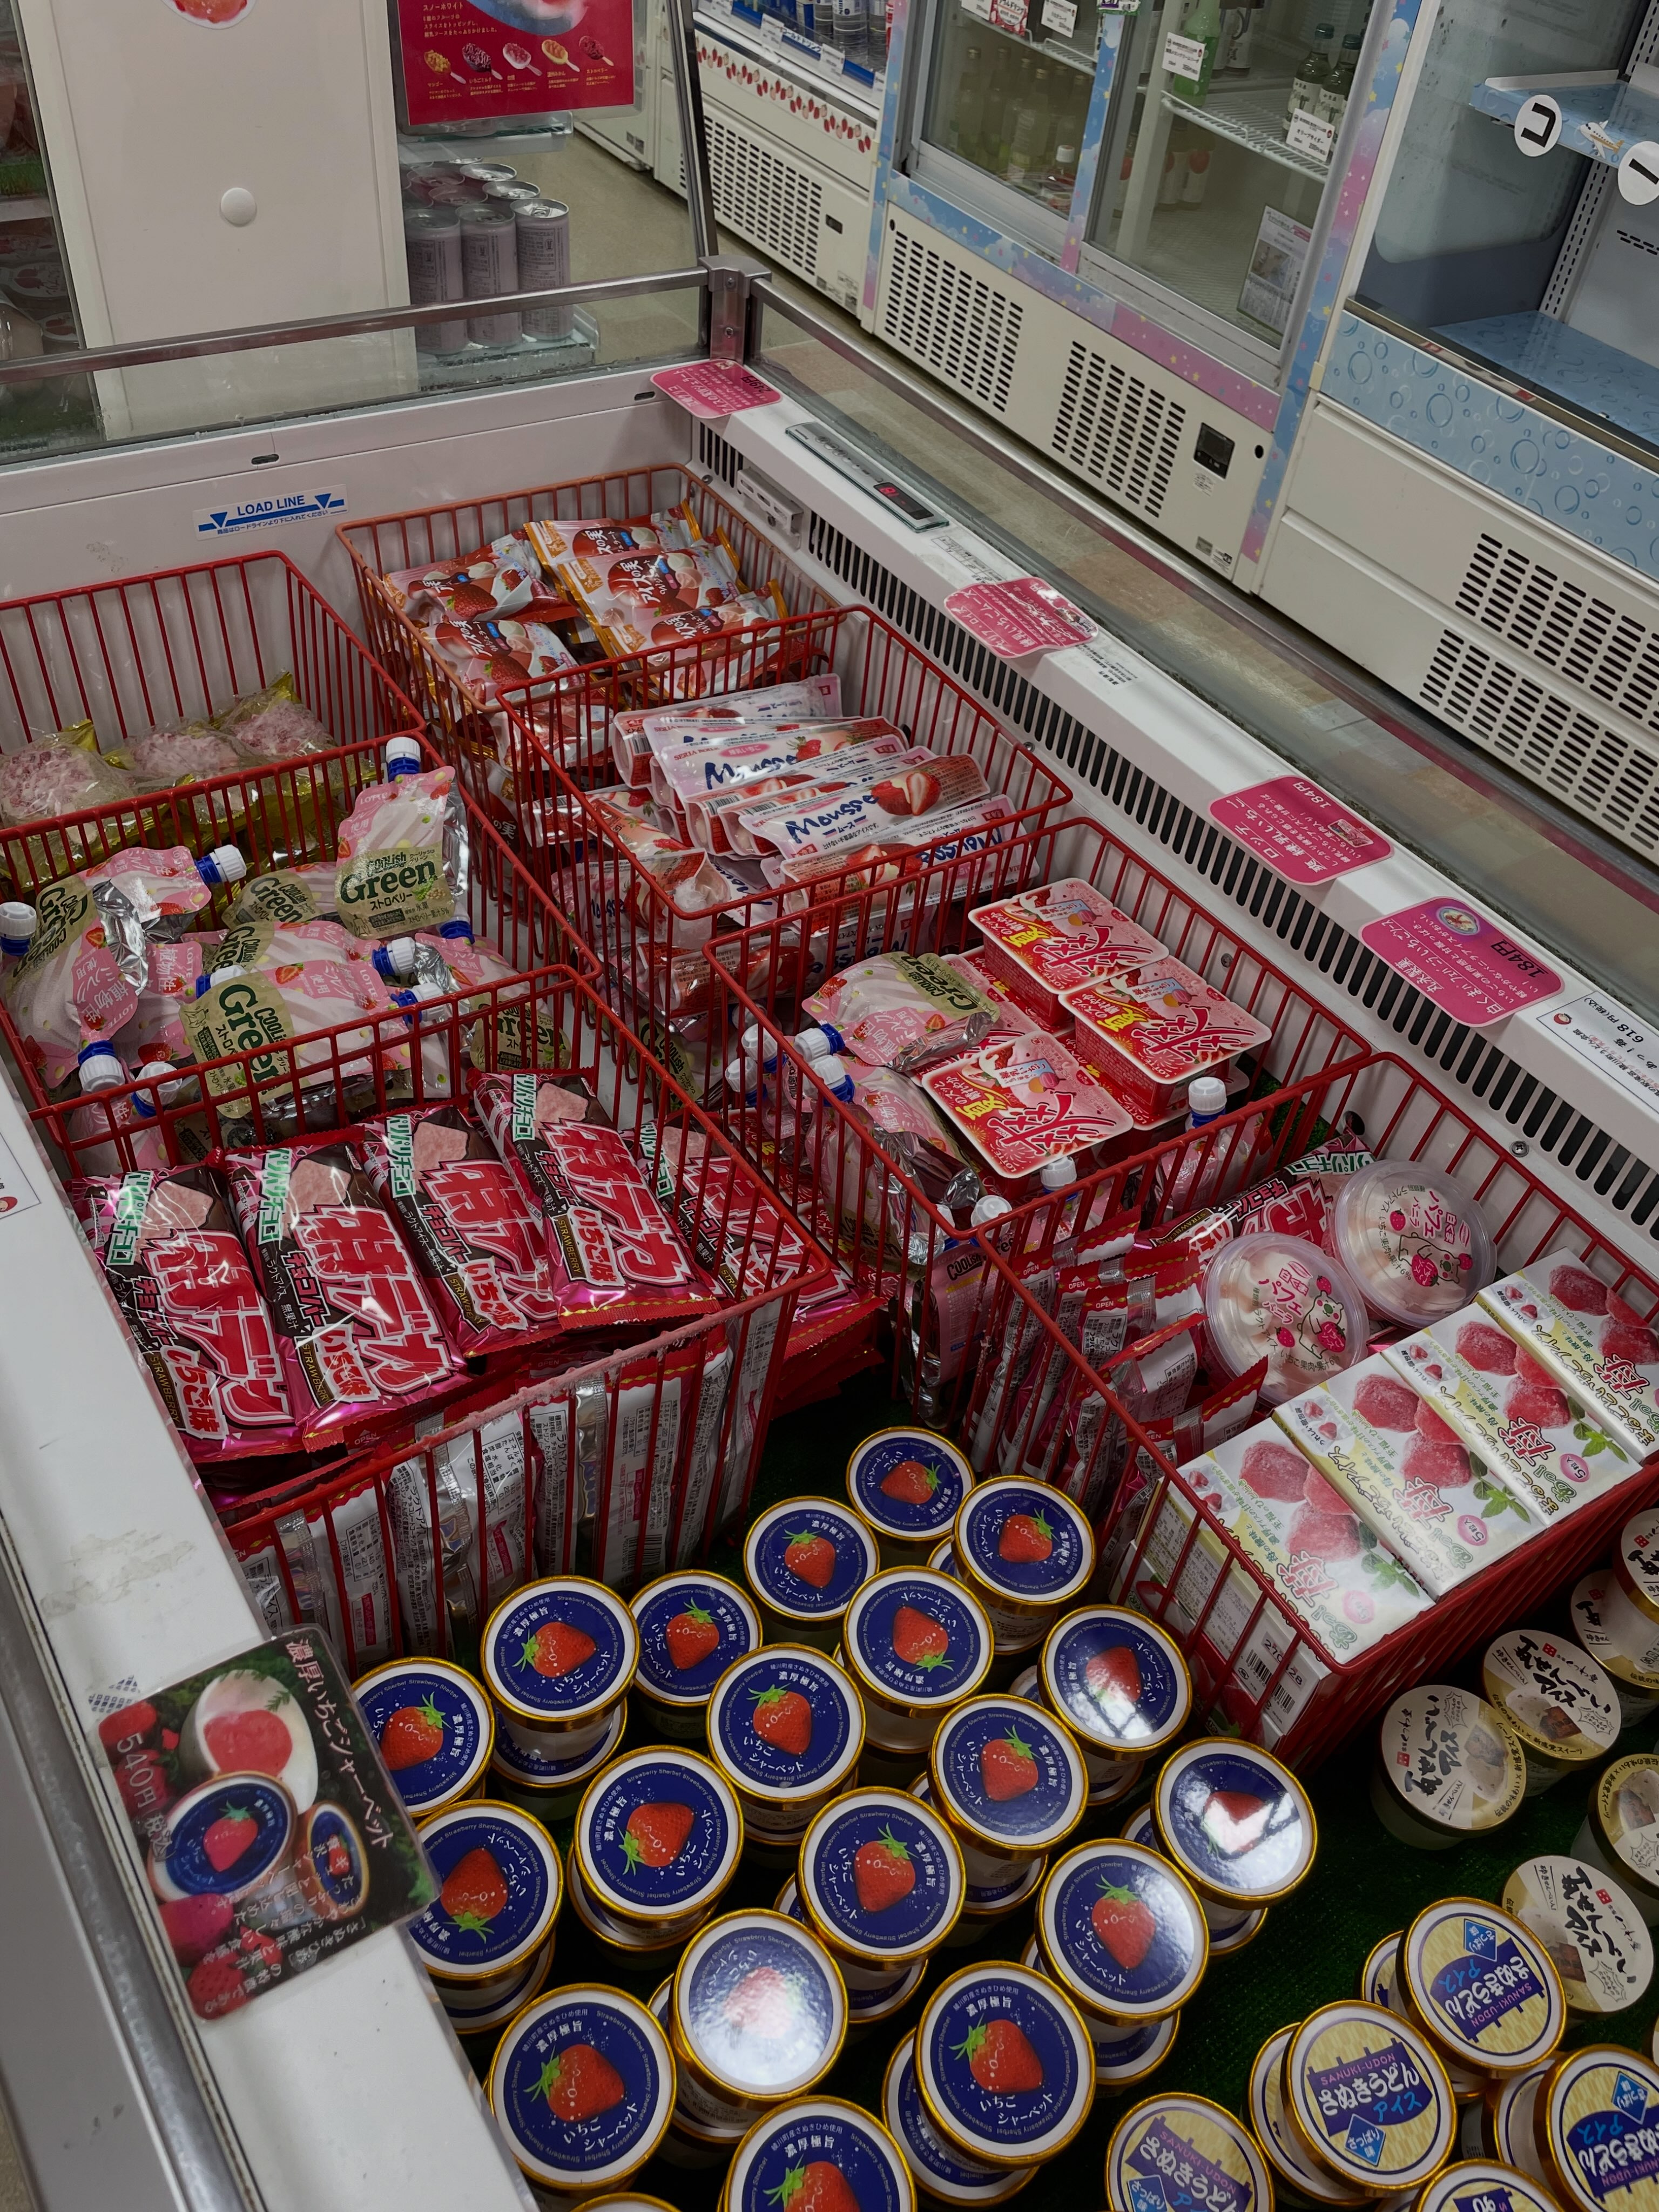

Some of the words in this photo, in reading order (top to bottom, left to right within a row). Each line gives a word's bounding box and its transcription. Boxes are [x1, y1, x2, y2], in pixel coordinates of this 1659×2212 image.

[740, 376, 773, 393] 249円
[217, 510, 328, 535] 商品はロードラインより下に入れてください
[237, 502, 273, 516] LOAD
[276, 495, 305, 509] LINE
[1293, 781, 1332, 809] 184円
[786, 794, 880, 844] Mousse
[838, 822, 855, 833] ムース
[1226, 798, 1305, 857] 練乳いちご
[1257, 803, 1338, 867] しっかり練乳を感じられる
[1260, 794, 1351, 864] 練乳いちごアイスに甘酸っぱ
[1235, 825, 1279, 859] ロッテ
[340, 861, 438, 903] Green
[1305, 858, 1325, 873] 爽
[249, 876, 302, 922] Green
[369, 894, 413, 911] ストロベリー
[1002, 925, 1053, 948] 夏
[1033, 925, 1154, 976] 爽
[157, 949, 177, 991] 植物性
[1419, 913, 1528, 999] 軽やかなバニラアイスがおいし
[1491, 938, 1548, 978] 184円
[311, 973, 330, 994] 使用
[360, 968, 379, 998] LOTTE
[901, 955, 978, 1010] Green
[908, 972, 946, 997] COOLish
[1042, 971, 1063, 989] LOTTE
[1394, 957, 1444, 994] 丸永製菓
[84, 980, 129, 1025] 植物性
[107, 1003, 134, 1028] LOTTE
[1097, 1007, 1150, 1032] 夏
[1131, 1006, 1256, 1063] 爽
[1617, 1024, 1644, 1043] 618
[1143, 1058, 1170, 1078] LOTTE
[513, 1074, 536, 1141] パリパリチョコ
[955, 1092, 1010, 1120] 夏
[987, 1091, 1116, 1156] 爽
[994, 1148, 1016, 1172] LOTTE
[421, 1204, 471, 1263] チョコバー
[558, 1219, 581, 1273] STRAWBERRY
[572, 1208, 617, 1283] いちご味
[266, 1260, 288, 1301] ラクトアイス
[282, 1250, 329, 1325] チョコバー
[1023, 1265, 1040, 1275] OPEN
[1068, 1281, 1085, 1290] OPEN
[1279, 1268, 1309, 1296] 白くま
[466, 1264, 521, 1327] いちご味
[1258, 1278, 1304, 1318] パフェ
[1262, 1300, 1293, 1325] バニラ
[281, 1304, 299, 1330] 無果汁
[302, 1343, 331, 1405] STRAWBERRY
[318, 1327, 372, 1397] いちご味
[1594, 1354, 1650, 1400] 苺
[150, 1355, 180, 1424] STRAWBERRY
[167, 1348, 220, 1432] いちご味
[355, 1433, 377, 1445] OPEN
[1498, 1417, 1555, 1467] 苺
[867, 1451, 890, 1489] シャーベット
[885, 1451, 903, 1469] いちご
[1566, 1458, 1587, 1479] 5粒入
[1393, 1477, 1454, 1529] 苺
[981, 1514, 994, 1561] シャーベット
[992, 1509, 1003, 1536] いちご
[1463, 1517, 1483, 1542] 5粒入
[774, 1565, 800, 1587] いちご
[777, 1581, 824, 1601] シャーベット
[1277, 1551, 1339, 1607] 苺
[900, 1591, 953, 1618] シャーベット
[930, 1608, 957, 1627] いちご
[650, 1623, 665, 1650] いちご
[573, 1650, 610, 1695] シャーベット
[646, 1637, 672, 1679] シャーベット
[554, 1668, 584, 1692] いちご
[1533, 1673, 1576, 1707] アイス
[285, 1637, 394, 1848] 濃厚いちごシャーベット
[968, 1741, 980, 1773] いちご
[1439, 1730, 1462, 1776] アイス
[956, 1753, 983, 1806] シャーベット
[1566, 1905, 1602, 1958] アイス
[1438, 1960, 1482, 1991] アイス
[1444, 1954, 1530, 2022] さぬきうどん
[1470, 1981, 1533, 2028] SANUKI-UDON
[1320, 2052, 1396, 2086] SANUKI-UDON
[1318, 2063, 1420, 2116] さぬきうどん
[1373, 2090, 1423, 2121] アイス
[1345, 2122, 1382, 2152] さっぱり
[1582, 2113, 1624, 2143] アイス
[1159, 2130, 1237, 2194] SANUKI-UDON
